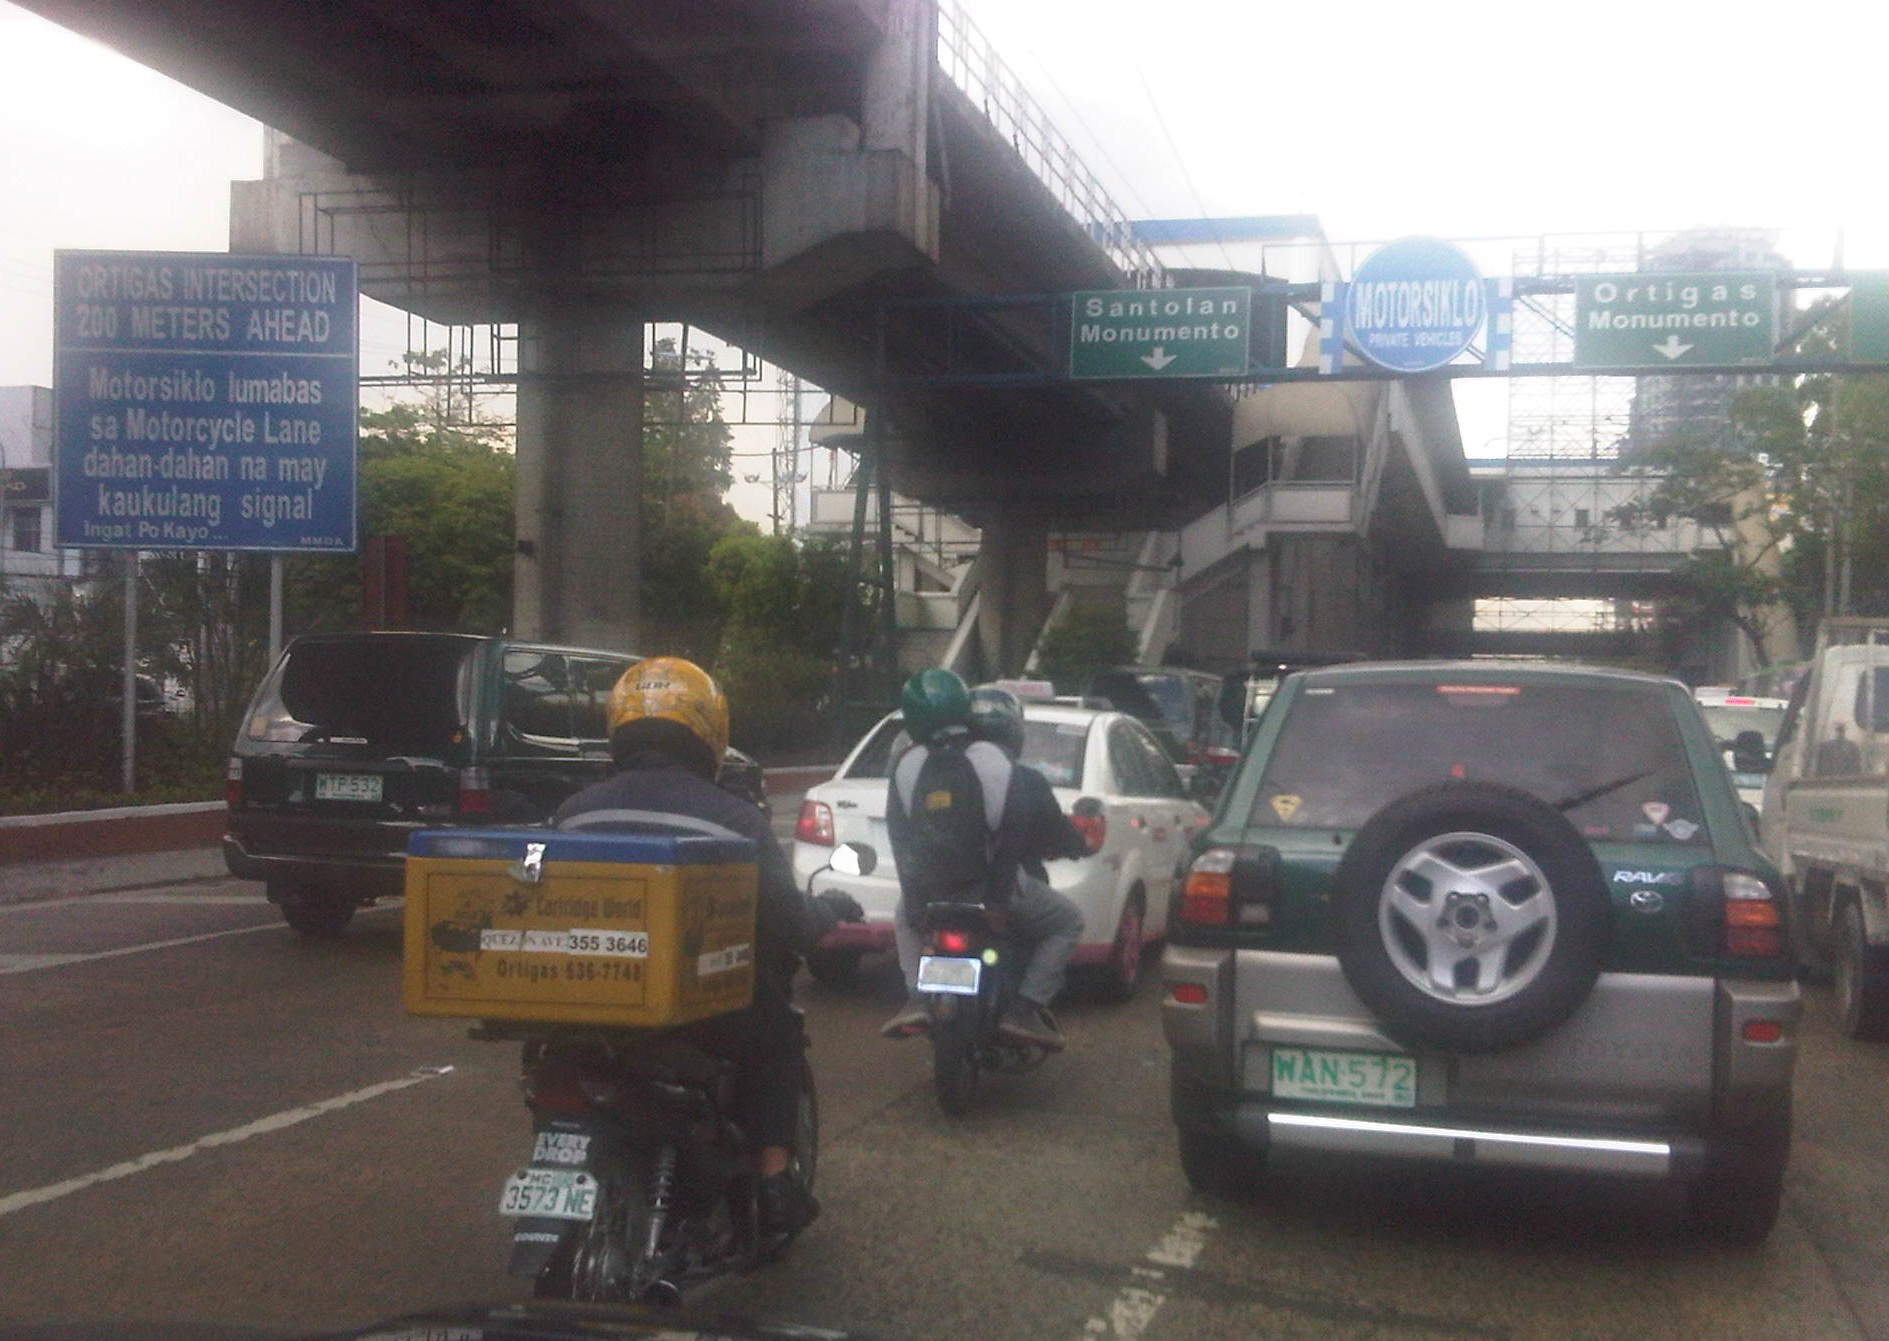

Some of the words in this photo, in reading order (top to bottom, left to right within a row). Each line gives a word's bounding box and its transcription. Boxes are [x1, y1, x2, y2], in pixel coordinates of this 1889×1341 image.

[77, 266, 173, 299] ORTIGAS
[183, 268, 337, 303] INTERSECTION
[1594, 282, 1757, 309] Ortigas
[1086, 296, 1237, 317] Santolan
[1355, 280, 1479, 328] MOTORSIKLO
[1588, 310, 1760, 330] Monumento
[77, 304, 119, 338] 200
[131, 306, 231, 340] METERS
[247, 310, 330, 343] AHEAD
[1080, 323, 1239, 343] Monumento
[88, 367, 216, 402] Motorsiklo
[229, 371, 322, 404] lumabas
[89, 414, 118, 441] sa
[126, 408, 255, 450] Motorcycle
[264, 411, 321, 445] Lane
[83, 447, 229, 480] dahan-dahan
[240, 456, 267, 480] na
[278, 456, 327, 490] may
[98, 483, 221, 526] kaukulang
[240, 487, 313, 528] signal
[84, 520, 131, 542] Ingat
[138, 521, 157, 538] Po
[569, 935, 600, 951] 355
[605, 936, 648, 954] 3646
